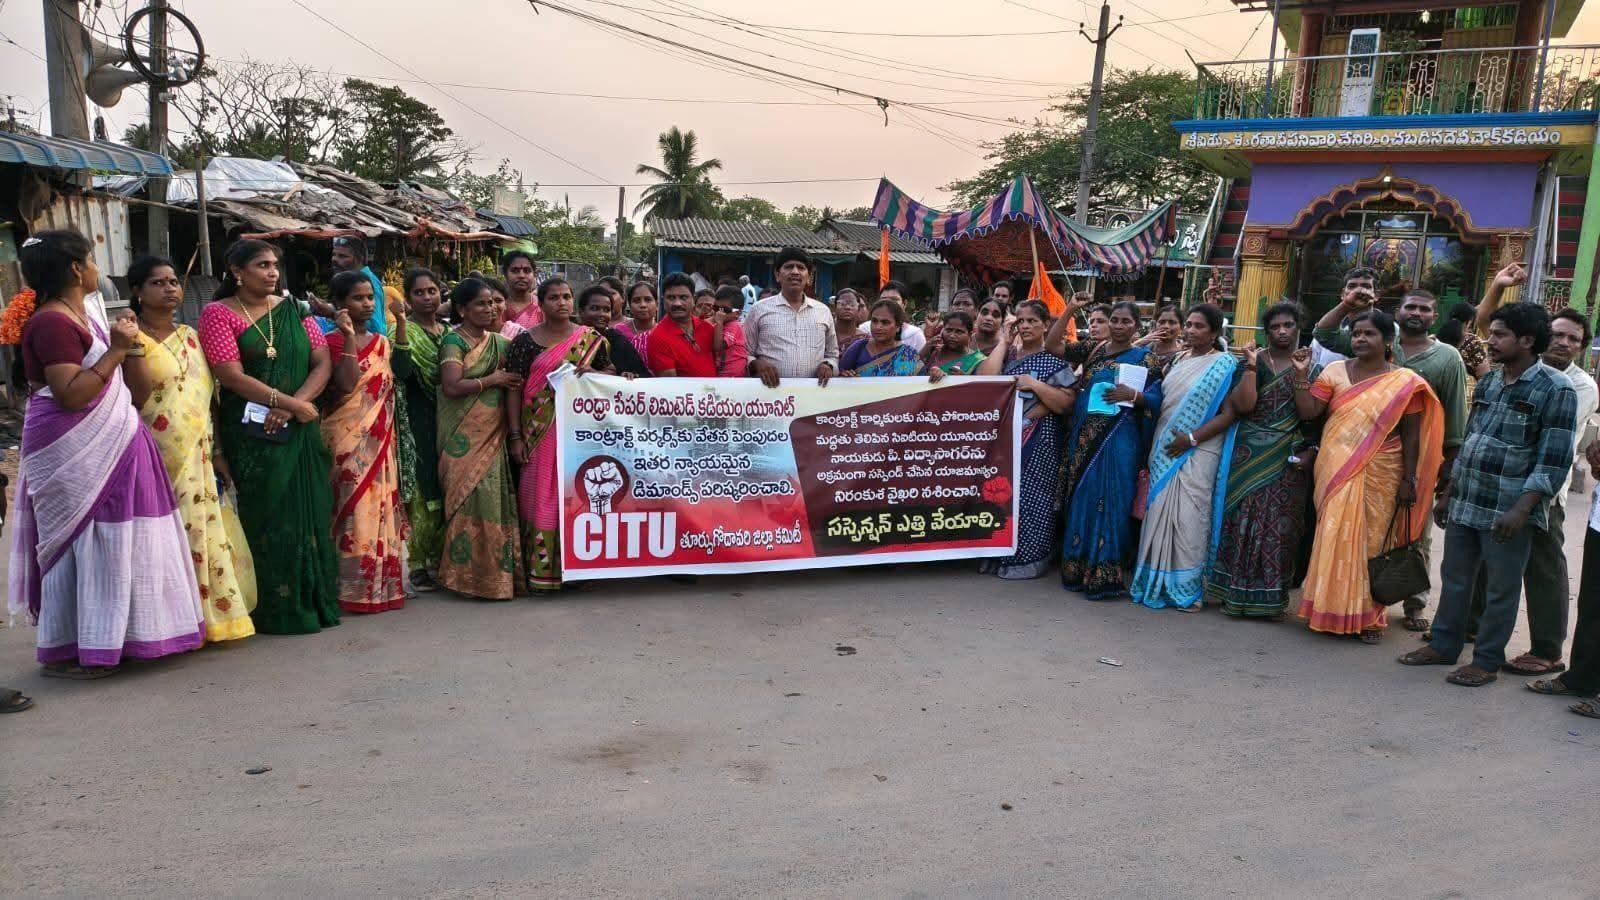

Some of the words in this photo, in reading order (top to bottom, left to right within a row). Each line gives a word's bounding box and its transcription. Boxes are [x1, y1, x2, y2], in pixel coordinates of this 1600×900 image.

[572, 396, 611, 421] ఆంధ్రా
[613, 390, 646, 416] పేపర్
[648, 393, 695, 416] లిమిటెడ్
[698, 393, 743, 417] కడియం
[745, 395, 795, 417] యూనిట్
[815, 411, 858, 429] కాంట్రాక్ట్
[859, 412, 915, 427] కార్మికులకు
[916, 411, 941, 426] సమ్మె
[941, 409, 1000, 422] పోరాటానికి
[574, 426, 634, 449] కాంట్రాక్ట్
[695, 425, 729, 443] వేతన
[731, 429, 789, 445] పెంపుదల
[854, 432, 890, 444] తెలిపిన
[939, 428, 998, 442] యూనియన్
[633, 456, 671, 471] ఇతర
[674, 454, 751, 475] న్యాయమైన
[830, 451, 886, 464] నాయకుడు
[816, 468, 866, 484] అక్రమంగా
[868, 465, 904, 482] సస్పెండ్
[905, 464, 933, 477] చేసిన
[934, 465, 998, 479] యాజమాన్యం
[633, 479, 699, 504] డిమాండ్స్
[700, 479, 795, 502] పరిష్కరించాలి.
[834, 487, 886, 503] నిరంకుశ
[887, 486, 919, 504] వైఖరి
[774, 519, 802, 545] కమిటీ
[827, 512, 892, 543] సస్పెన్షన్
[896, 513, 926, 538] ఎత్తి
[930, 506, 1001, 530] వేయాలి.
[573, 511, 677, 561] CITU
